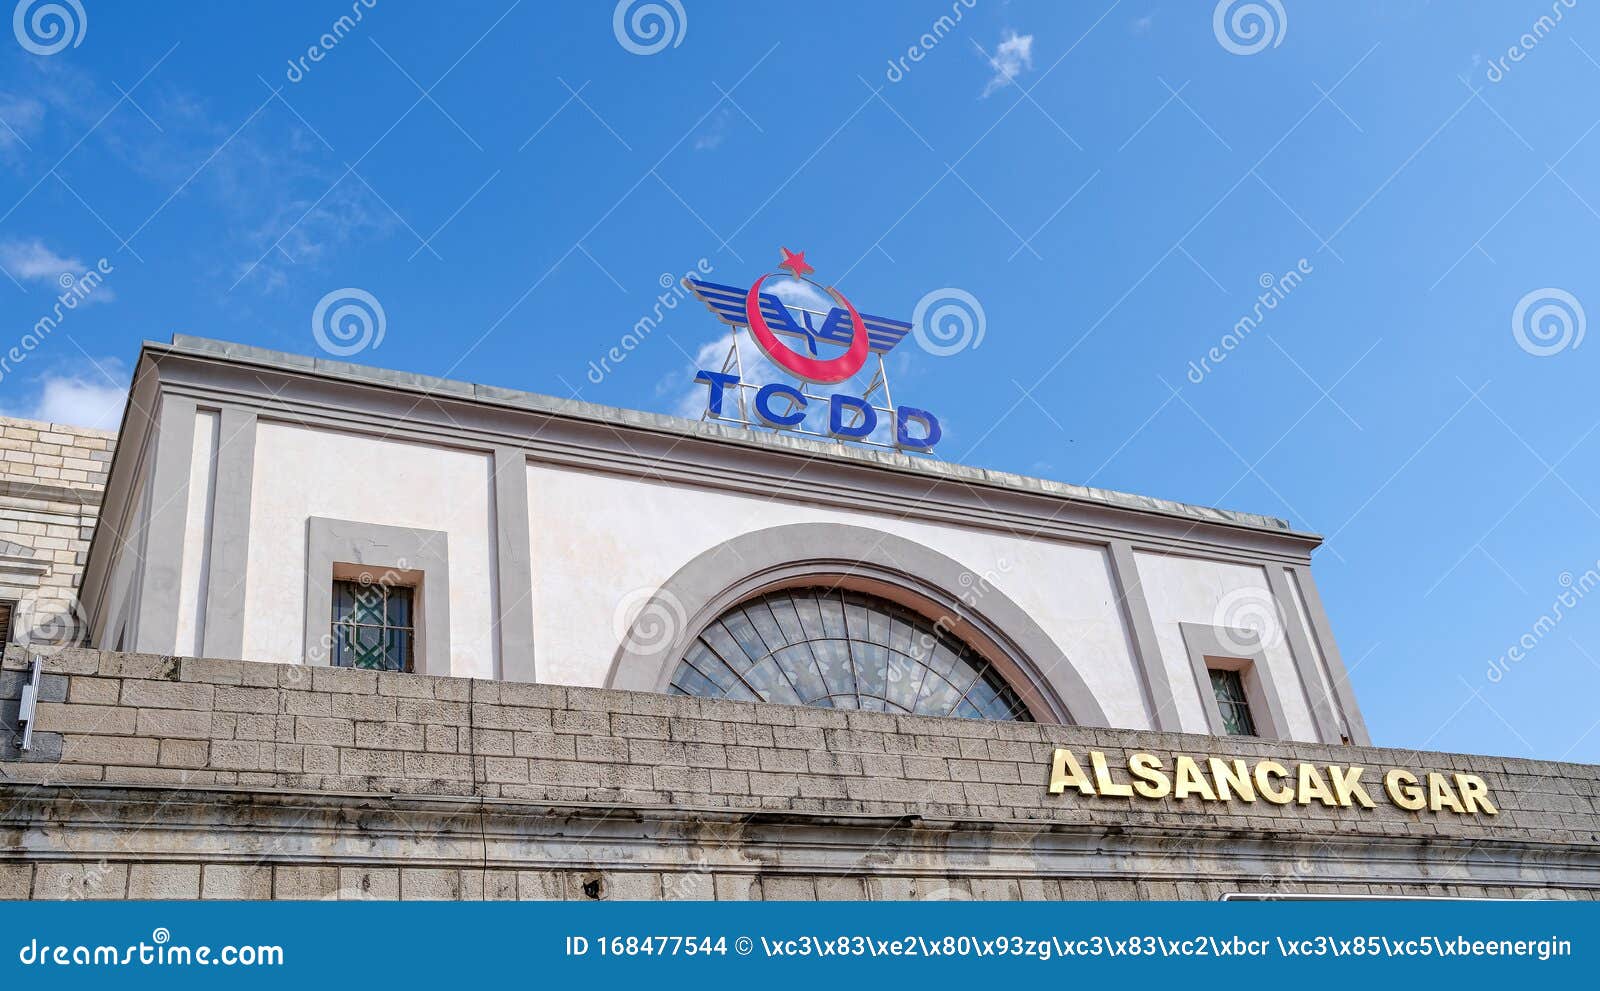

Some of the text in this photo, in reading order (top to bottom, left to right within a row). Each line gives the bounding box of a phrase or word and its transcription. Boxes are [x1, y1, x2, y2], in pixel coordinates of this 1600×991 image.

[693, 370, 942, 450] TCDD
[1048, 748, 1498, 815] ALSANCAK GAR
